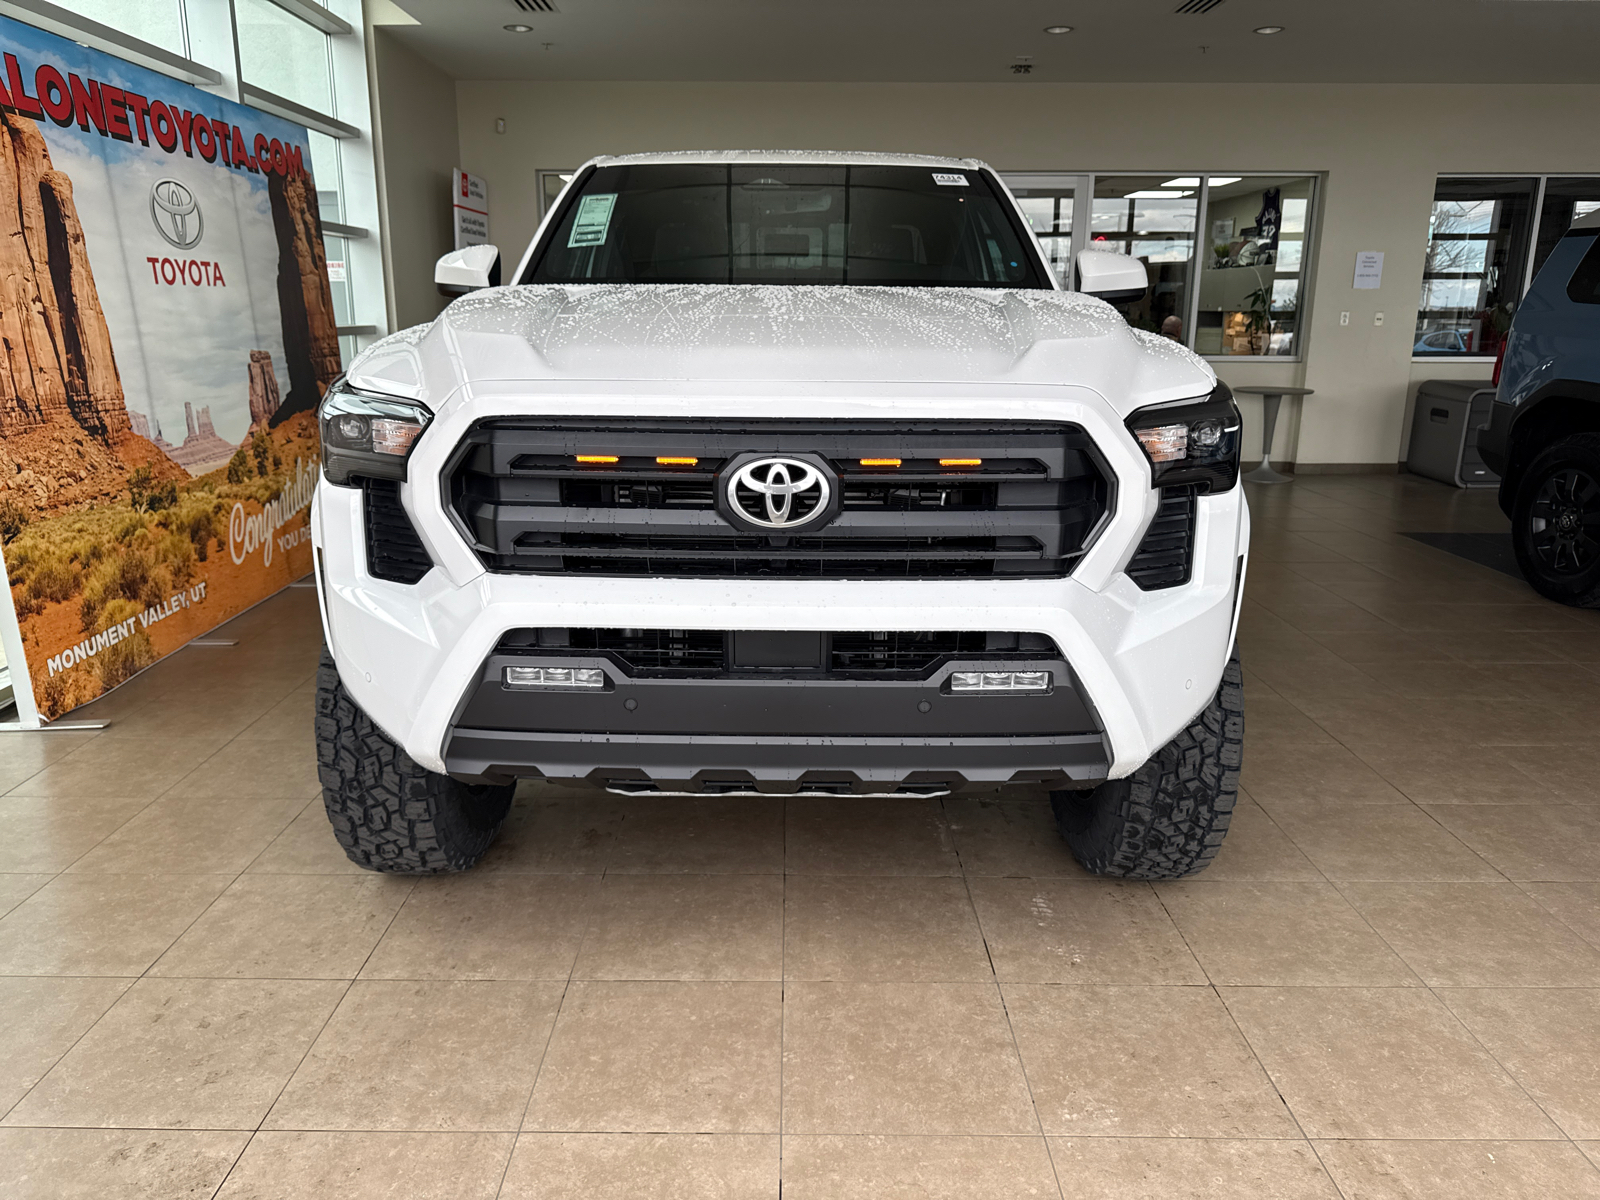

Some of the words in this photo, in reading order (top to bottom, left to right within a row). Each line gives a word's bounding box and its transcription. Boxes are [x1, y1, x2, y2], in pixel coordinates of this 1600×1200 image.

[146, 256, 226, 287] TOYOTA
[229, 453, 320, 568] Congratulati
[277, 530, 299, 553] YOU
[46, 616, 136, 678] MONUMENT
[138, 590, 190, 629] VALLEY,
[190, 581, 207, 604] UT
